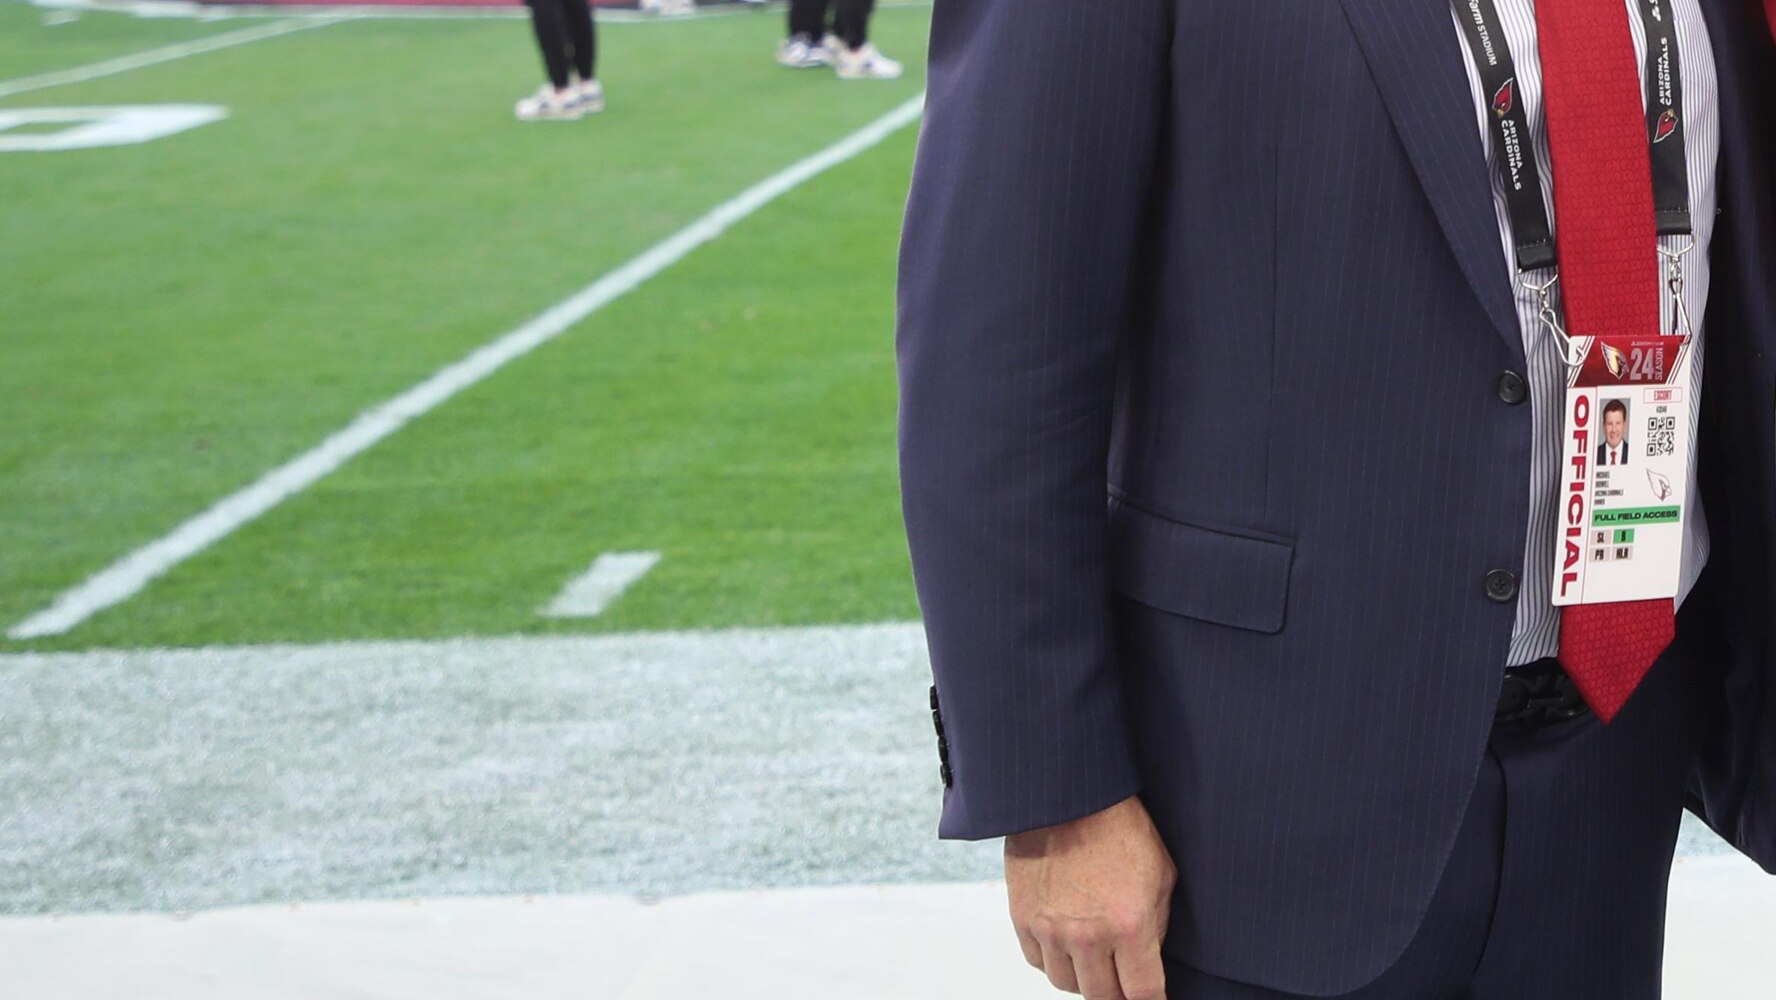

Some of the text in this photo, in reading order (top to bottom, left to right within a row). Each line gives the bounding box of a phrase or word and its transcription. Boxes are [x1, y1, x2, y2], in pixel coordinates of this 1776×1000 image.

[1477, 25, 1497, 66] STADIUM
[1657, 56, 1665, 106] ARIZONA
[1660, 37, 1673, 106] CARDINALS
[1501, 119, 1522, 192] CARDINALS
[1507, 119, 1523, 170] ARIZONA
[1630, 348, 1654, 381] 24
[1655, 347, 1664, 381] SEASON
[1560, 395, 1590, 598] OFFICIAL
[1594, 514, 1616, 522] FULL
[1642, 510, 1678, 519] ACCESS
